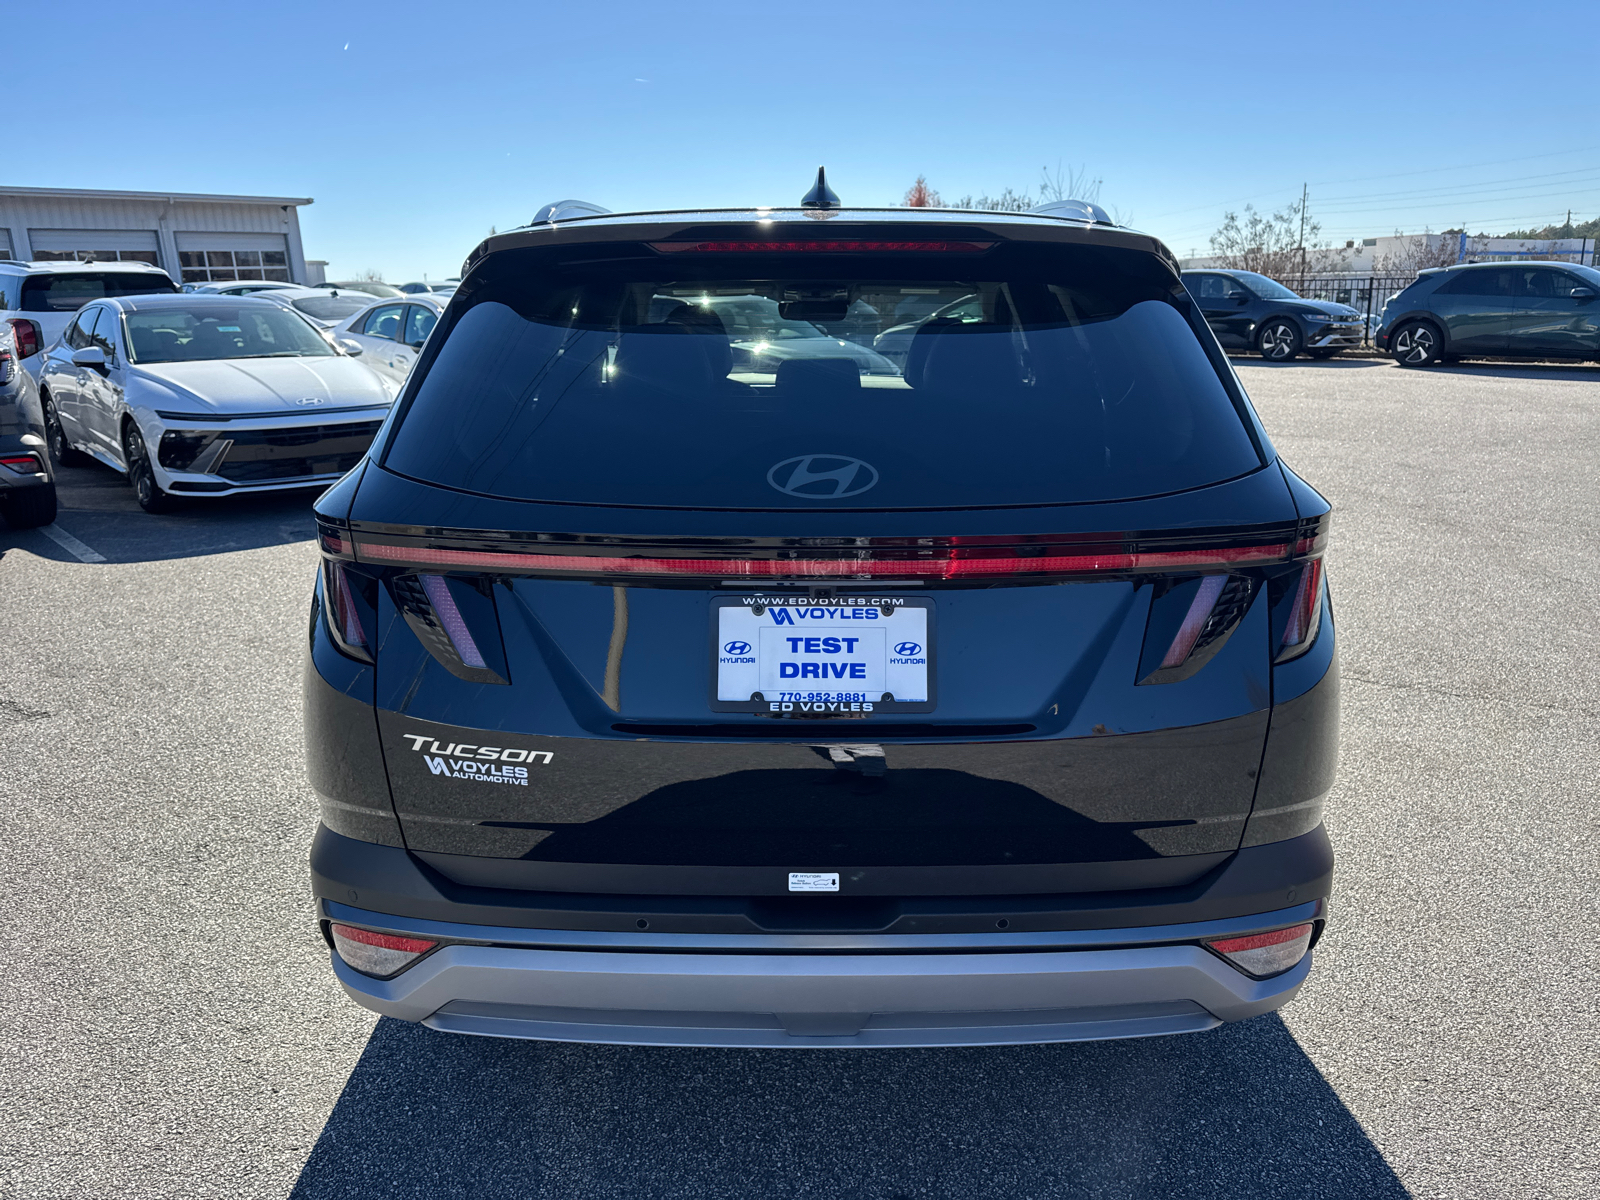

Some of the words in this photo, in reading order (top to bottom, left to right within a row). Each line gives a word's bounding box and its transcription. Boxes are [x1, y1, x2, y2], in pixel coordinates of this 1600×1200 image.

[742, 597, 904, 606] WWW.EDVOYLES.COM
[795, 607, 879, 620] VOYLES
[786, 637, 859, 654] TEST
[779, 662, 866, 679] DRIVE
[779, 692, 866, 702] 770-952-8881
[769, 702, 794, 712] ED
[802, 702, 874, 712] VOYLES
[449, 758, 528, 779] VOYLES
[451, 770, 529, 786] AUTOMOTIVE
